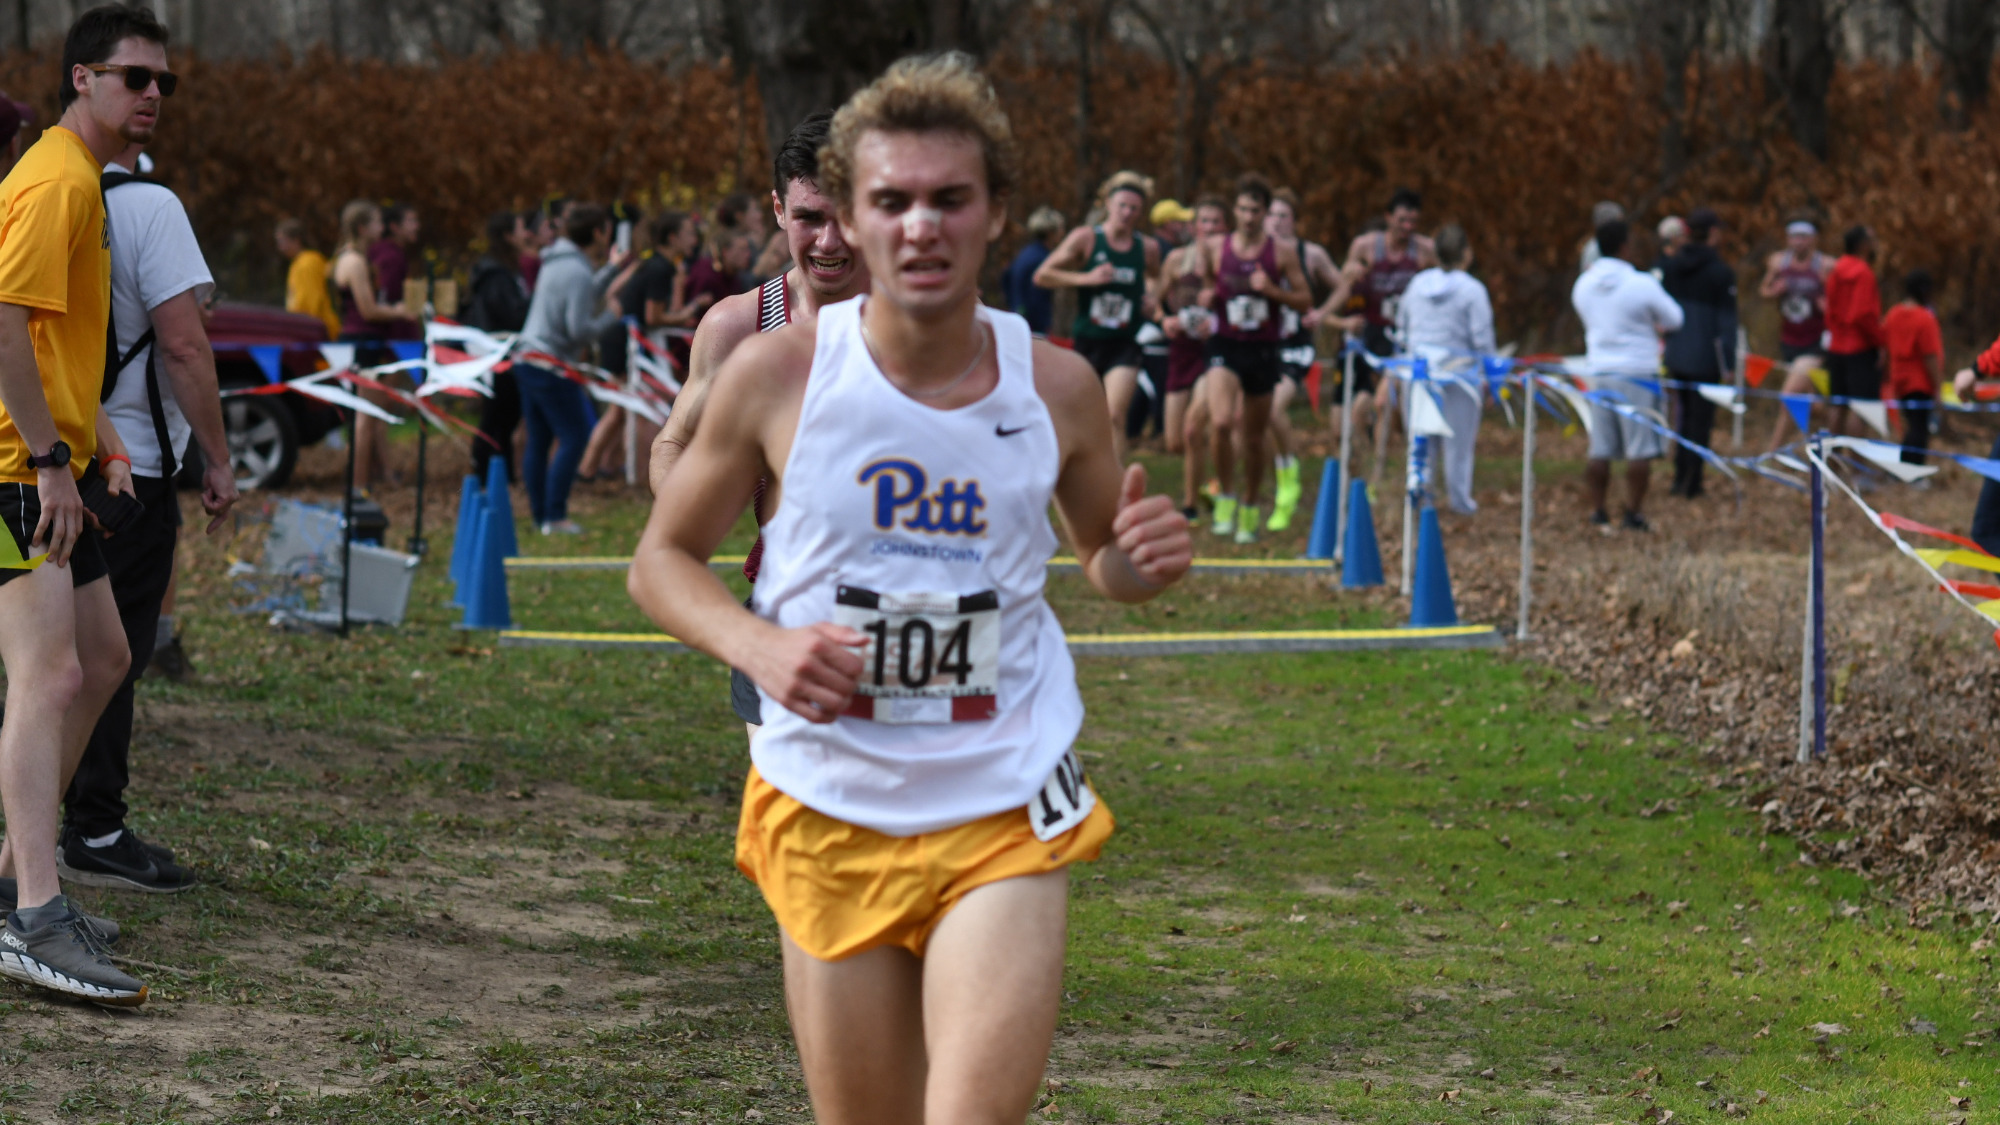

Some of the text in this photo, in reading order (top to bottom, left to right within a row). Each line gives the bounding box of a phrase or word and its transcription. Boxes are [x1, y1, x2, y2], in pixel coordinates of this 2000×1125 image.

[857, 457, 987, 535] Pitt
[870, 541, 982, 562] JOHNSTOWN
[863, 618, 973, 688] 104
[1039, 752, 1085, 827] 10
[0, 931, 28, 953] HOKA
